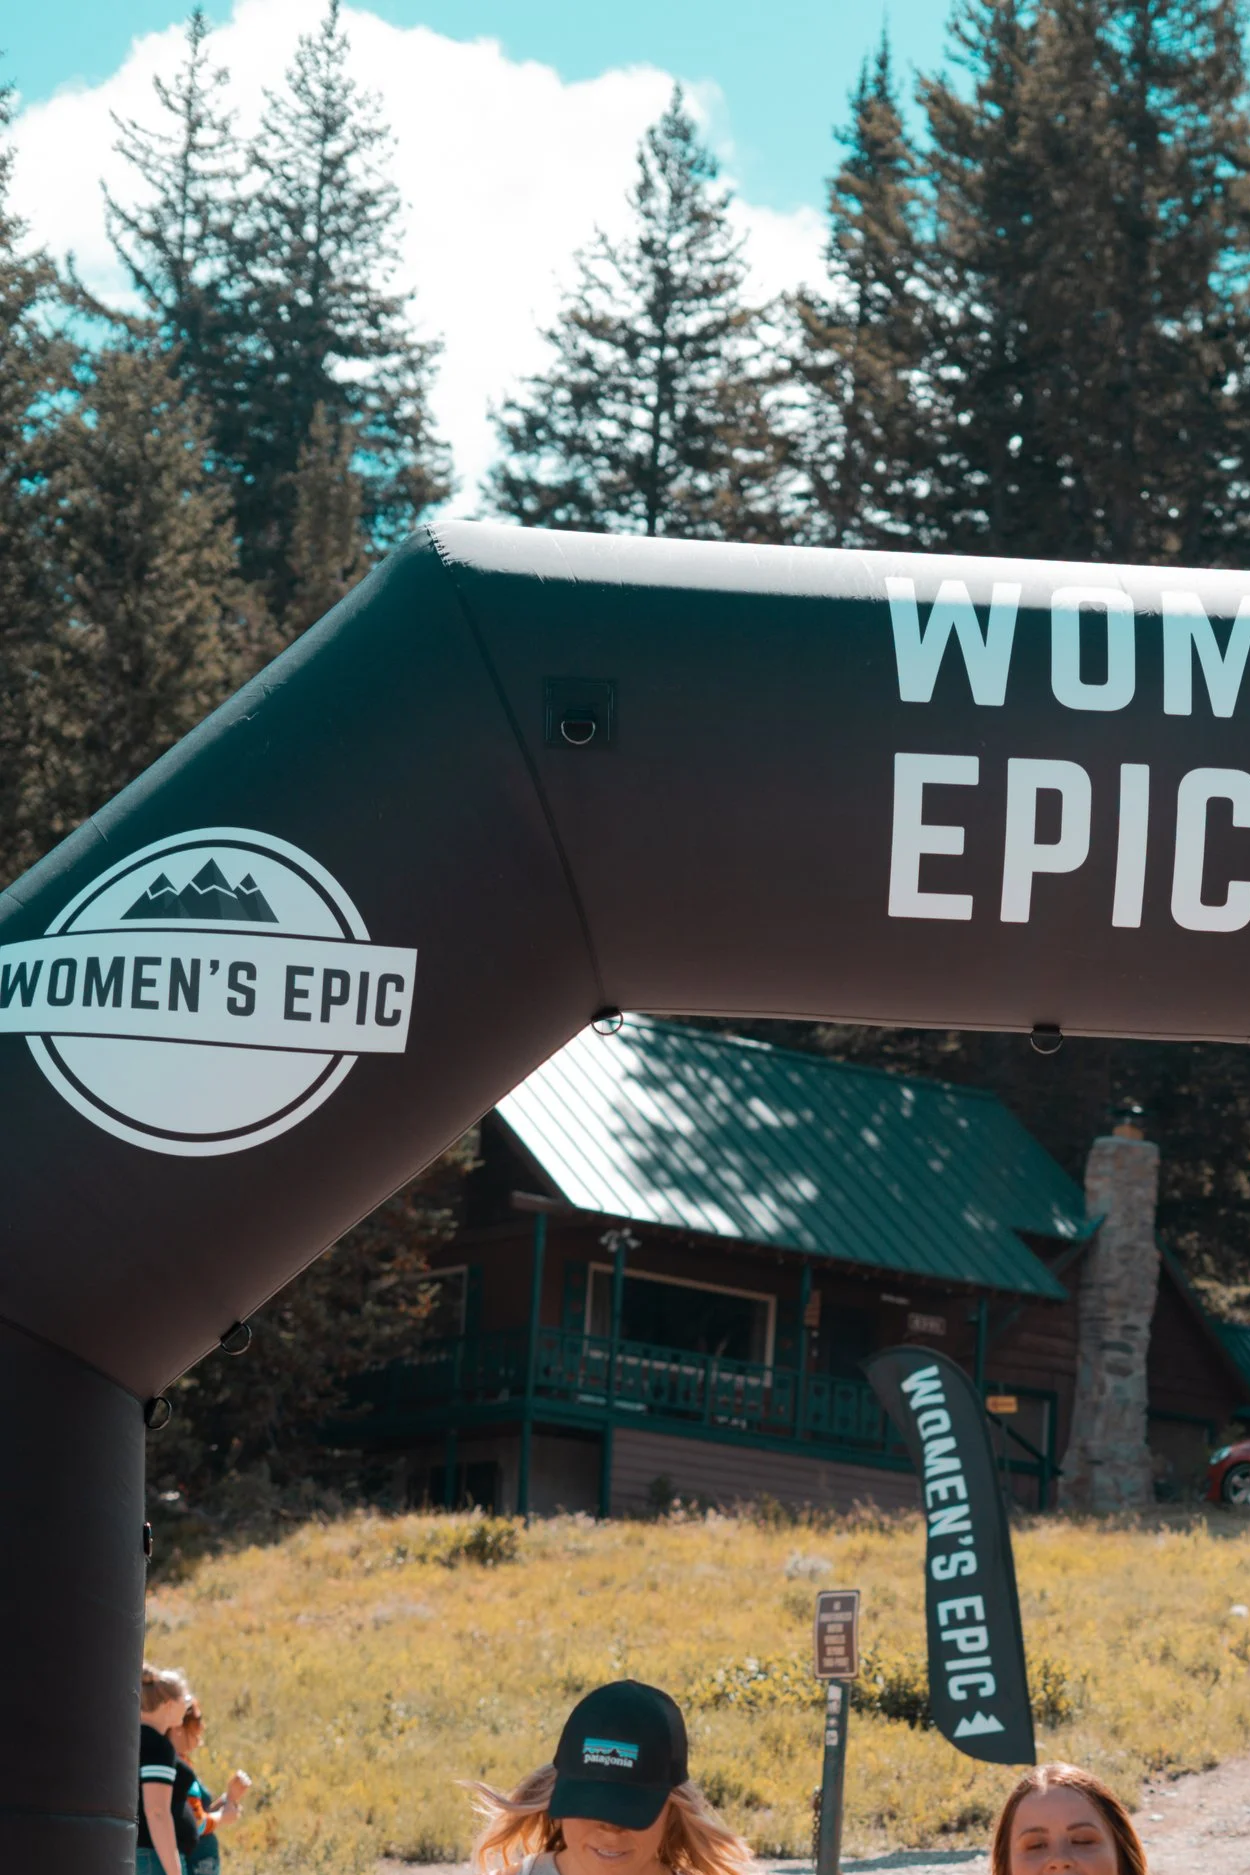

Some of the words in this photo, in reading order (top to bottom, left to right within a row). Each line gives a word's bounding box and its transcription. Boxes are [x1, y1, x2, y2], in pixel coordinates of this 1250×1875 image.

[0, 955, 258, 1017] WOMEN'S
[283, 964, 406, 1028] EPIC
[900, 1363, 978, 1582] WOMEN'S
[937, 1594, 997, 1701] EPIC
[584, 1754, 633, 1768] patagonia
